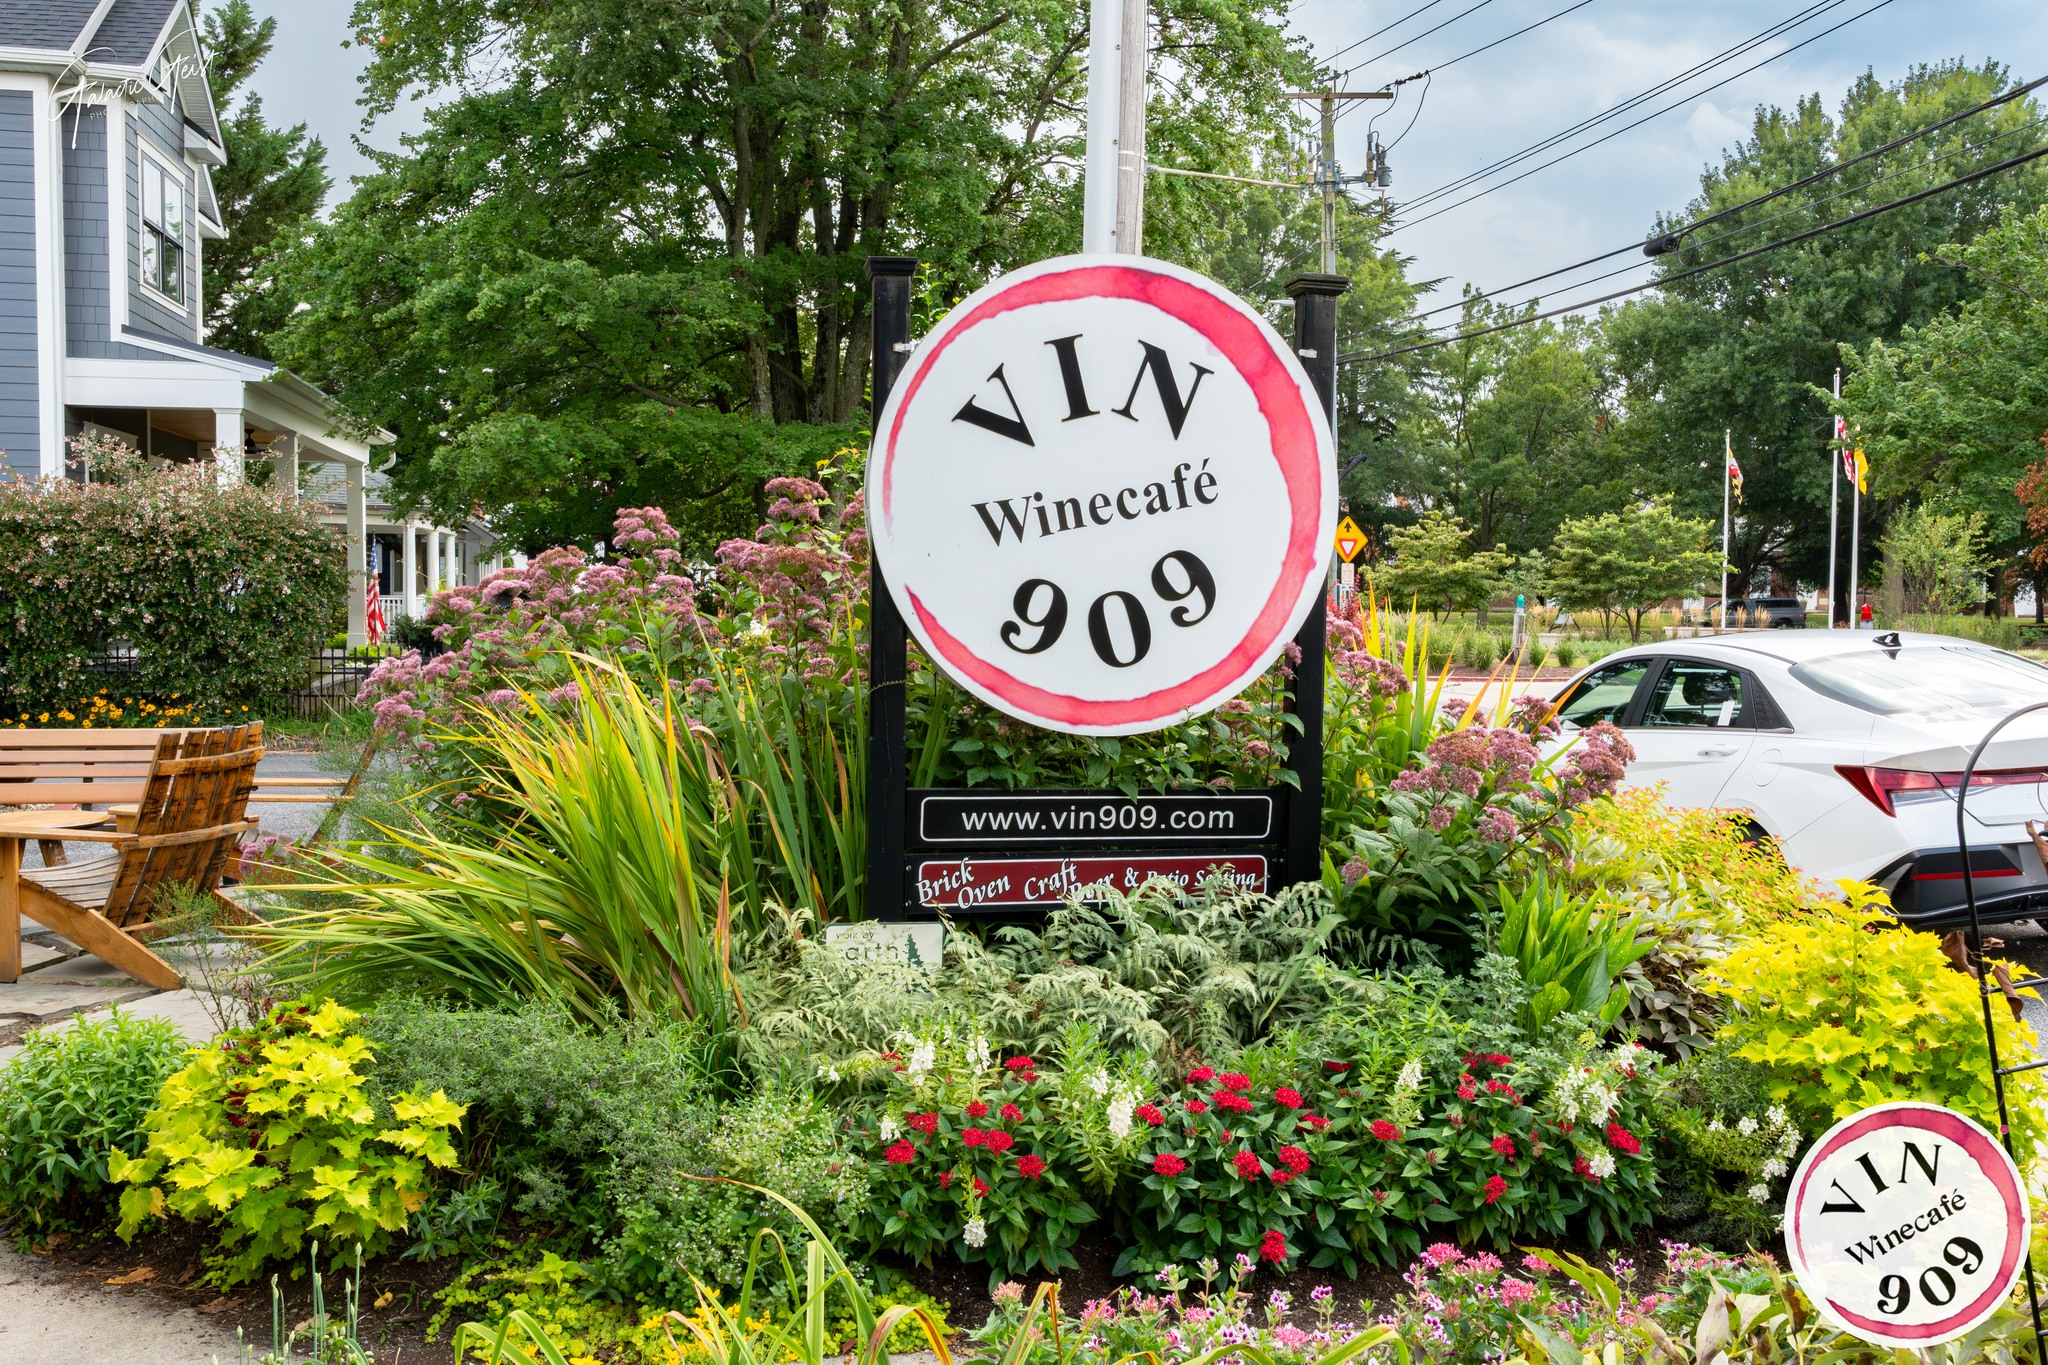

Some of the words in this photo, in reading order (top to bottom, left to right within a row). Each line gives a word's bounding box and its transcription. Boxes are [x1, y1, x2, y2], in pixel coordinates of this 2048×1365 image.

[951, 333, 1215, 447] VIN
[970, 457, 1219, 547] Winecafé
[1000, 549, 1217, 668] 909
[961, 805, 1234, 831] www.vin909.com
[916, 857, 974, 904] Brick
[957, 875, 1011, 909] Oven
[1024, 858, 1077, 901] Craft
[1124, 867, 1139, 888] &
[1819, 1141, 1942, 1216] VIN
[1844, 1188, 1967, 1266] Winecafé
[1877, 1236, 1984, 1315] 909
